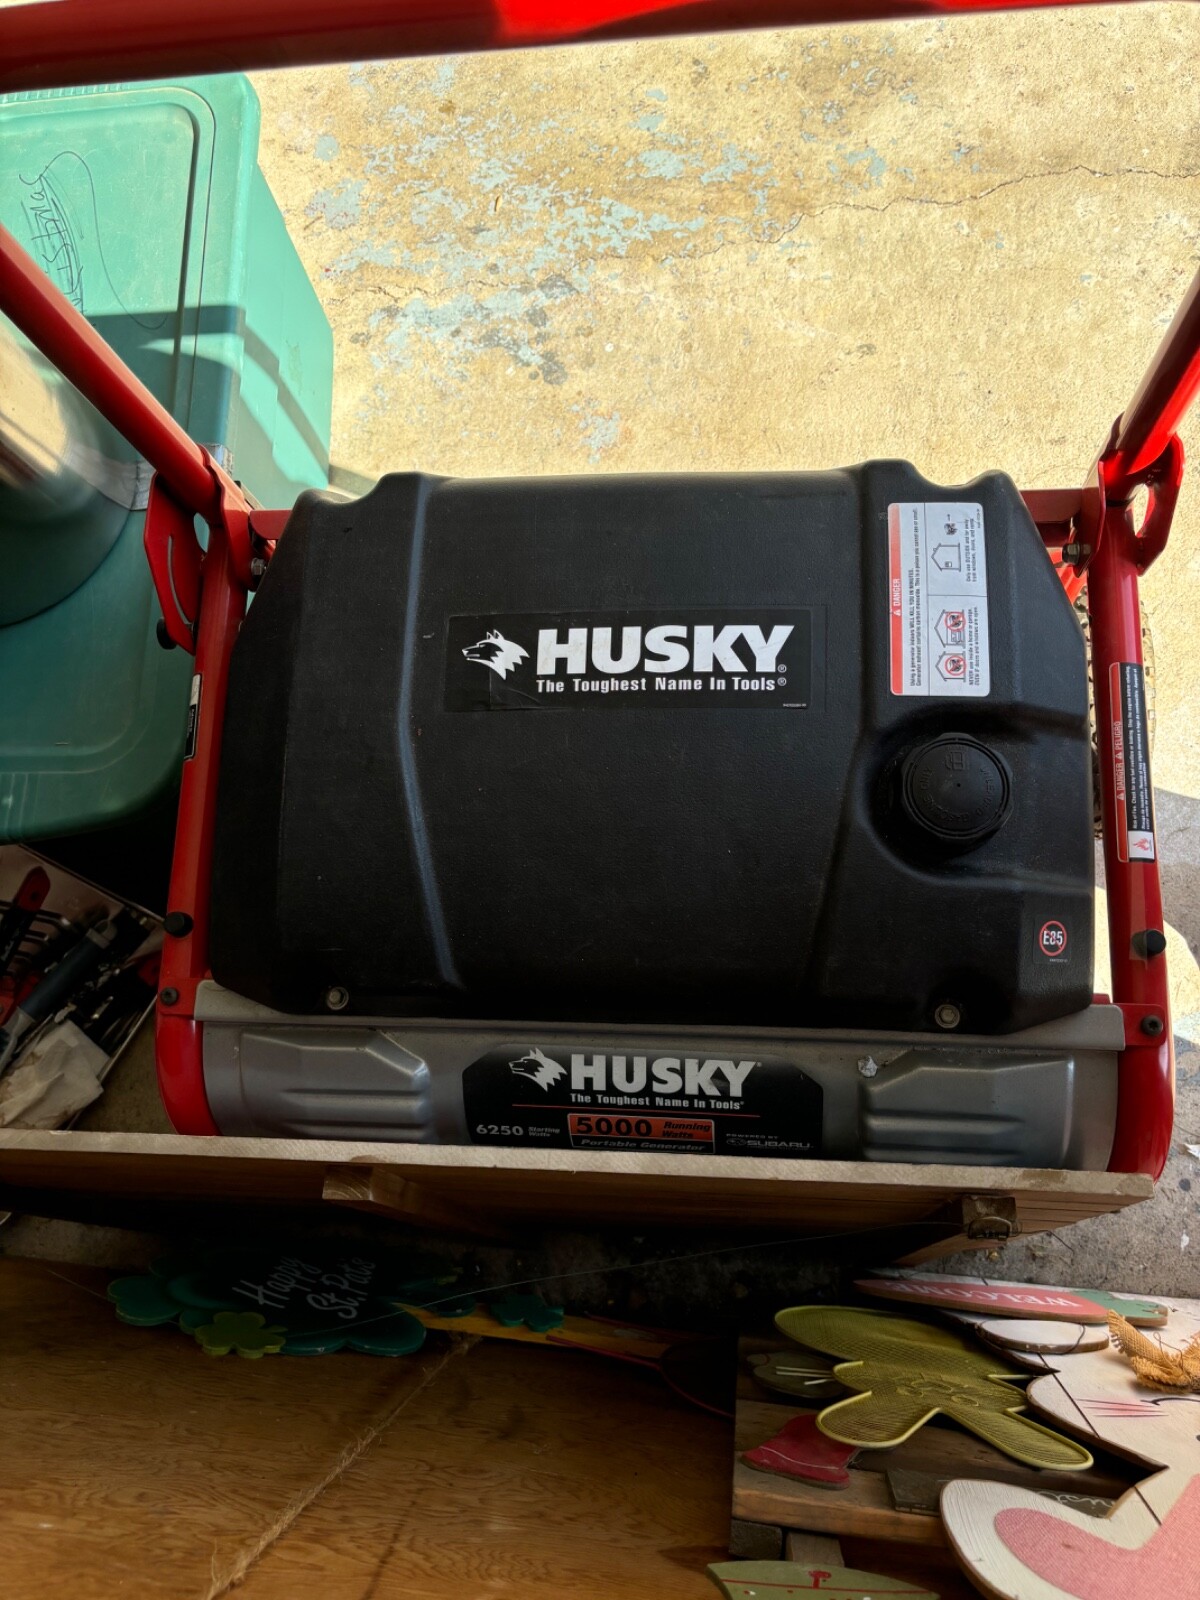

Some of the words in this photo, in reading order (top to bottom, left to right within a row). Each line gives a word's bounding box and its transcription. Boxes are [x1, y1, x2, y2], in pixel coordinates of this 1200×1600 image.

[892, 578, 901, 607] DANGER
[537, 625, 794, 675] HUSKY
[537, 679, 565, 693] The
[573, 677, 647, 694] Toughest
[655, 677, 702, 691] Name
[710, 677, 726, 691] In
[1114, 721, 1122, 750] PELIGRO
[1116, 762, 1124, 790] DANGER
[1043, 930, 1063, 945] E85
[571, 1053, 758, 1098] HUSKY
[570, 1093, 591, 1104] The
[596, 1094, 650, 1107] Toughest
[655, 1097, 690, 1108] Name
[694, 1098, 706, 1108] In
[475, 1124, 524, 1137] 6250
[575, 1117, 653, 1137] 5000
[662, 1120, 712, 1133] Running
[662, 1129, 694, 1139] Watts
[581, 1137, 633, 1149] Portable
[640, 1140, 707, 1152] Generator
[747, 1139, 811, 1148] SUBARU
[232, 1256, 322, 1309] Happy
[884, 1282, 1083, 1308] WELCOME
